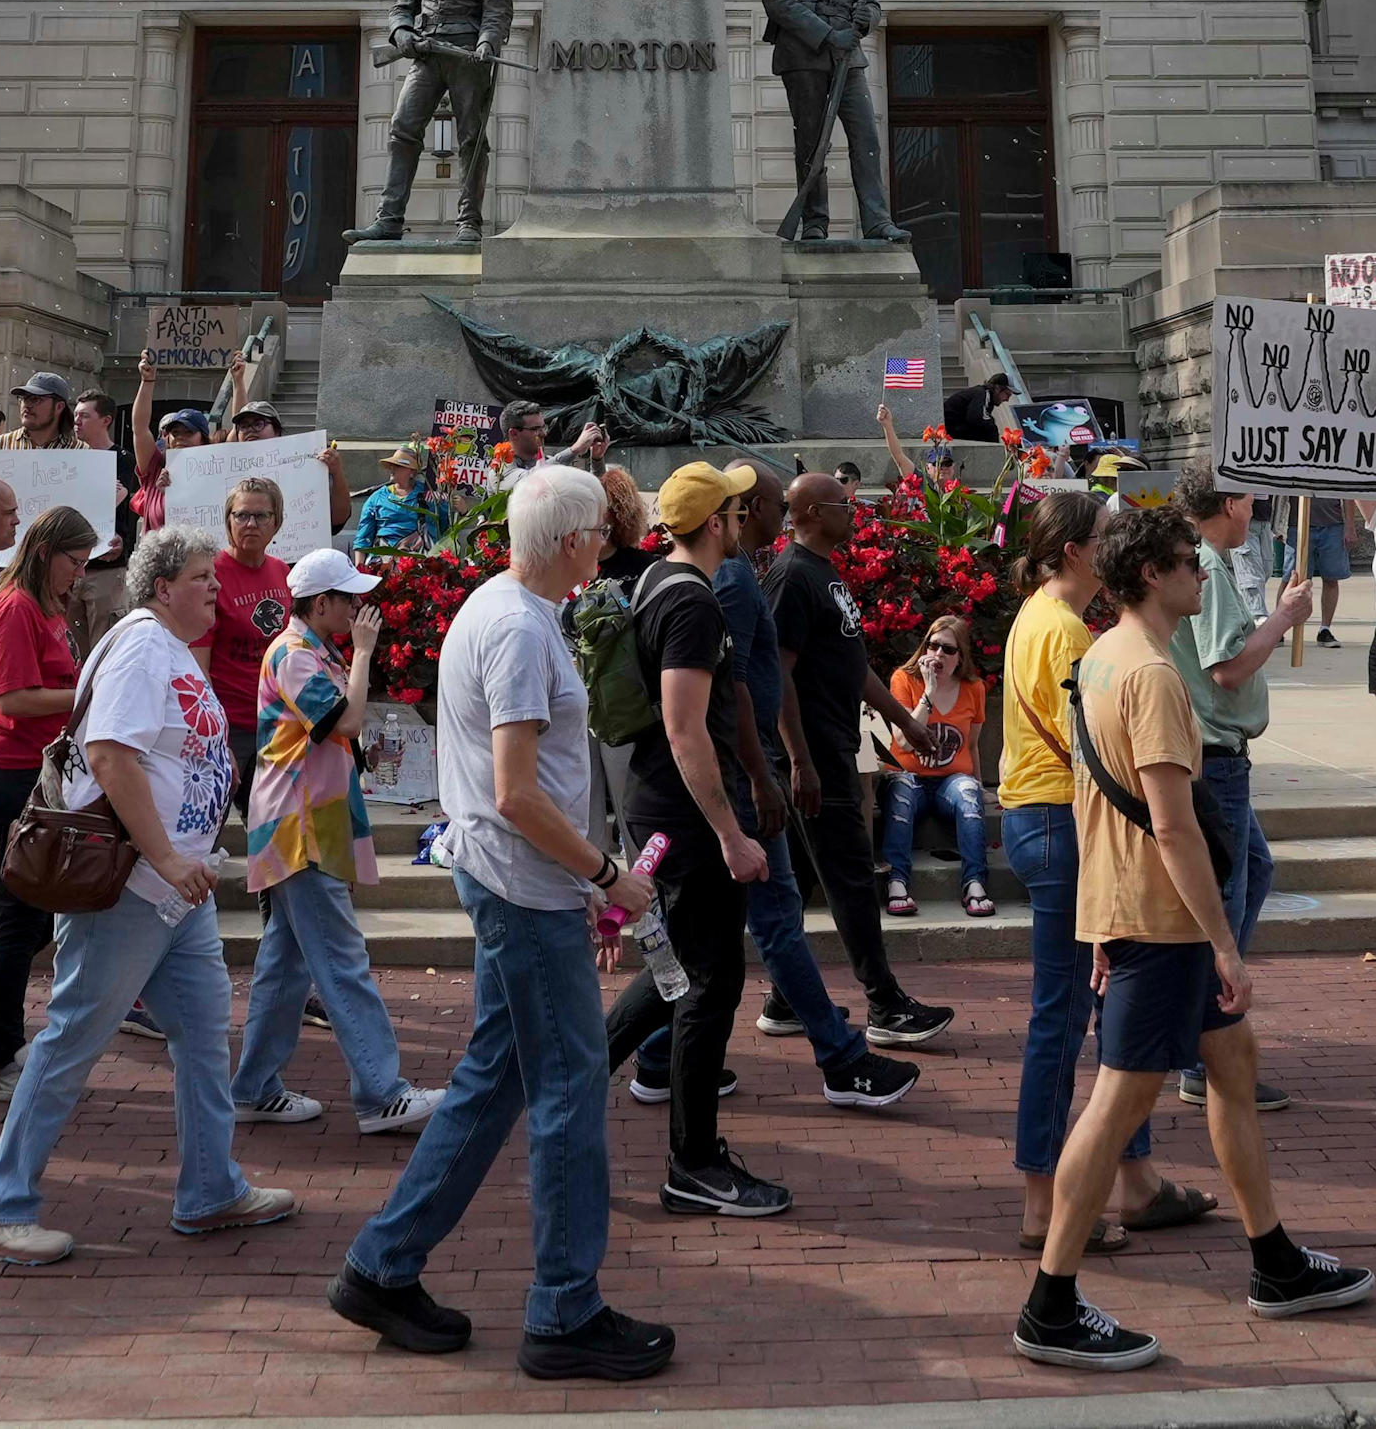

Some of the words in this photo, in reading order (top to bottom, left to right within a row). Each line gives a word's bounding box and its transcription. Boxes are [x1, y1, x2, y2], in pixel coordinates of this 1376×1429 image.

[552, 39, 717, 71] MORTON
[1351, 286, 1372, 300] IS
[163, 306, 206, 322] ANTI
[1225, 303, 1254, 329] NO
[1307, 307, 1335, 333] NO
[157, 319, 225, 339] FACISM
[173, 335, 202, 347] PRO
[147, 347, 231, 368] DEMOCRACY
[1263, 342, 1289, 367] NO
[1343, 349, 1370, 372] NO
[446, 401, 469, 413] GIVE
[472, 404, 488, 415] ME
[435, 411, 496, 429] RIBBERTY
[1232, 426, 1289, 463] JUST
[1299, 426, 1347, 464] SAY
[457, 457, 480, 468] GIVE
[483, 459, 491, 469] M
